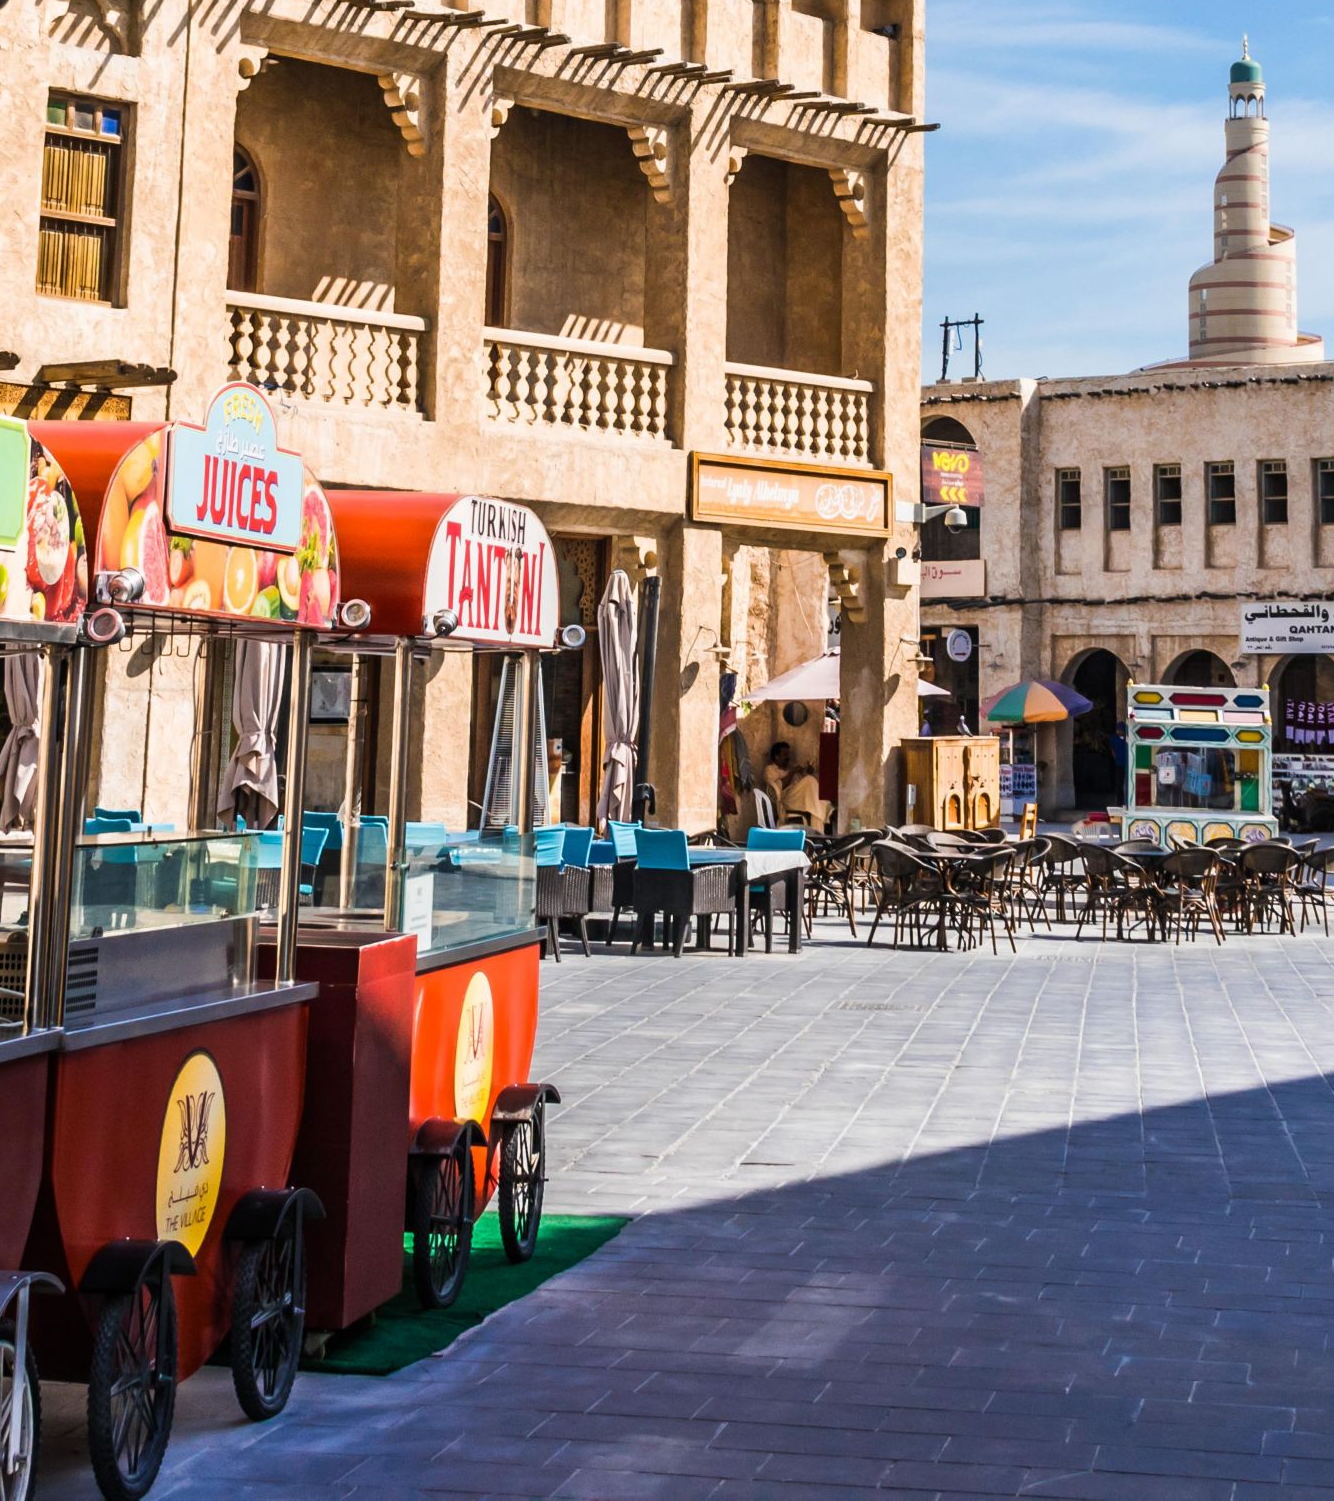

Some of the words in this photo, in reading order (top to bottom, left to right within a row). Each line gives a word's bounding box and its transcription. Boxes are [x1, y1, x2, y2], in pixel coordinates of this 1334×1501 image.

[223, 393, 264, 436] FRESH
[241, 440, 265, 461] عصير
[196, 454, 278, 535] JUICES
[471, 499, 527, 545] TURKISH
[1245, 604, 1330, 624] والقحطاني
[166, 1215, 179, 1233] THE
[180, 1206, 207, 1228] VILLAGE
